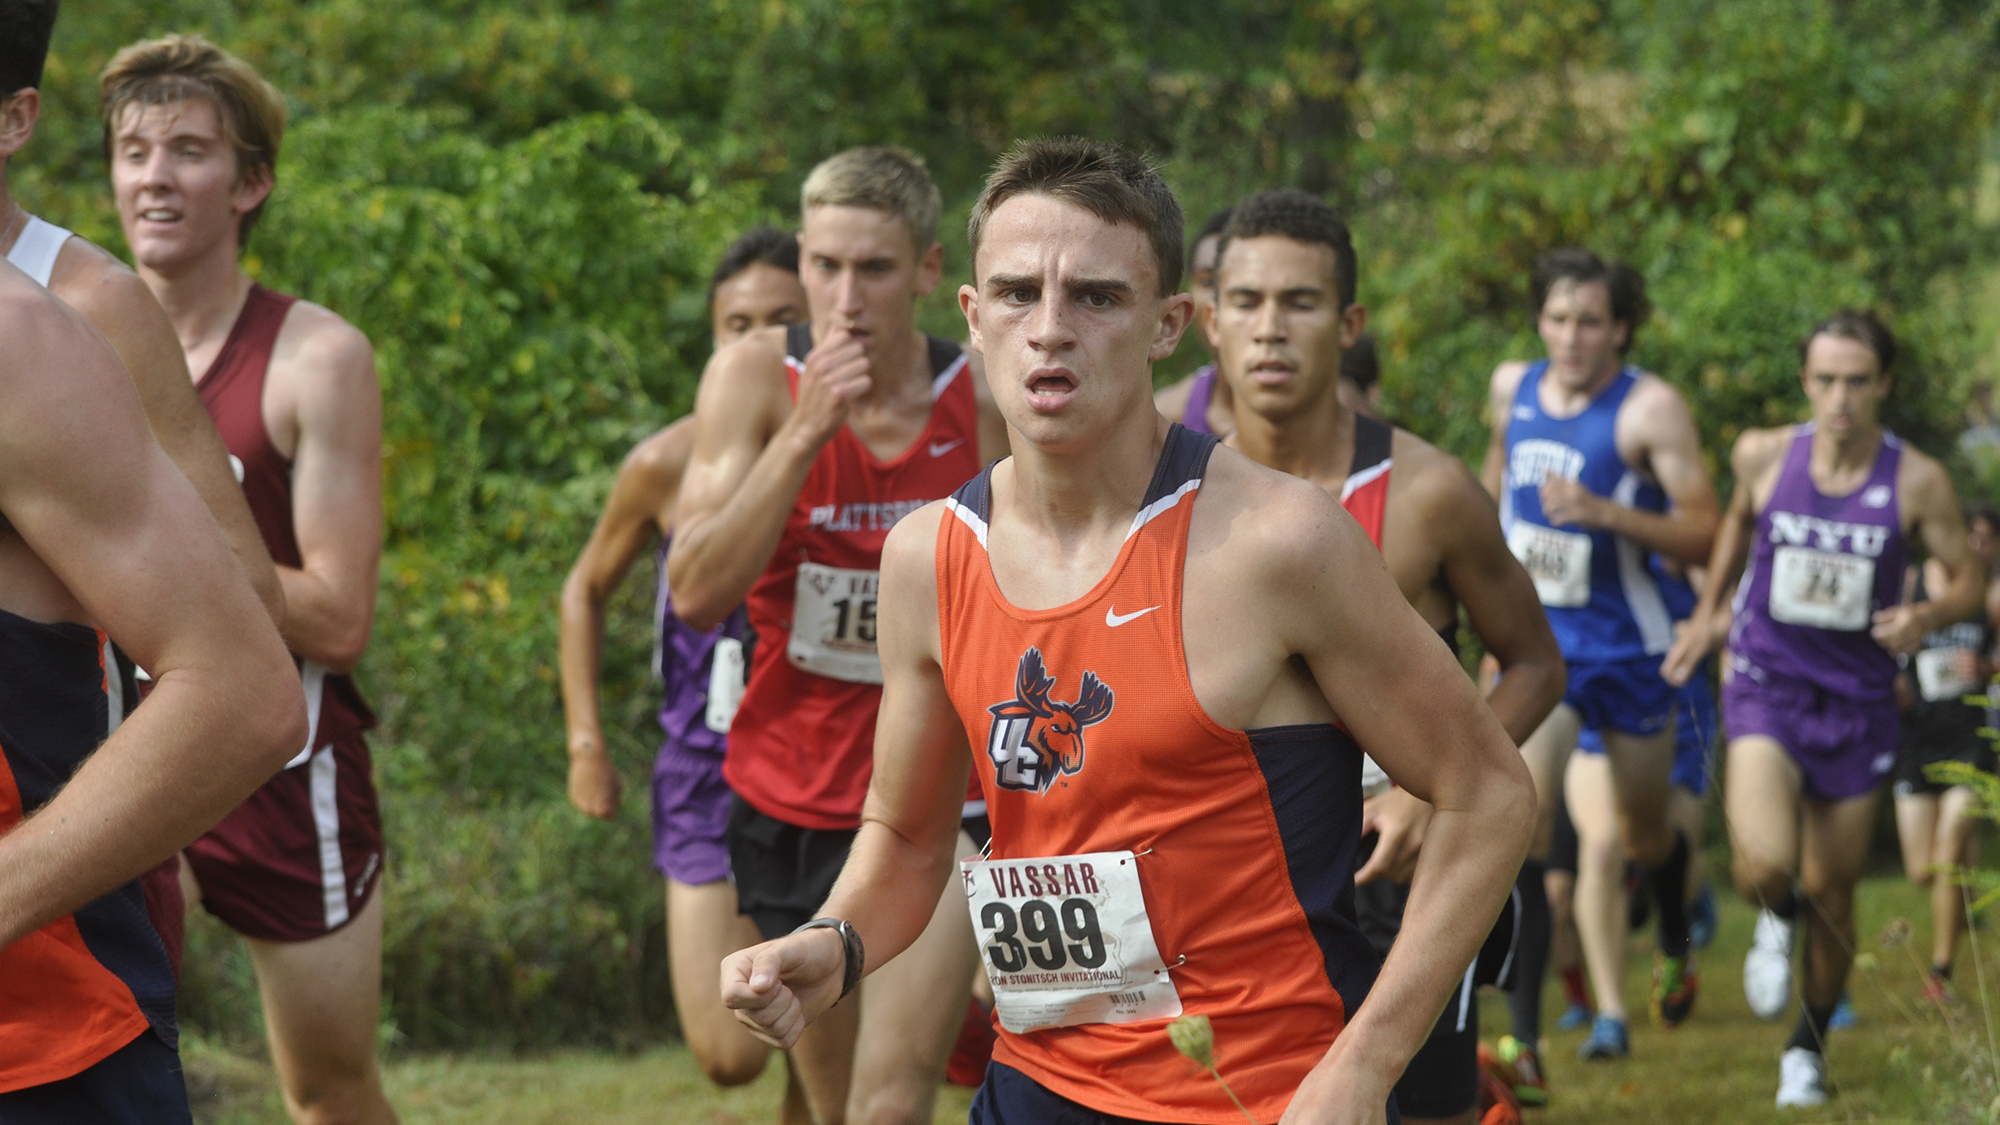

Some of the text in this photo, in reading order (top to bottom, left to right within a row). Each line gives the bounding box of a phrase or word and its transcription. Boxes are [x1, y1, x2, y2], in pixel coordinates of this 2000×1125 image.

[1769, 511, 1889, 556] NYU
[989, 863, 1099, 898] VASSAR
[980, 898, 1107, 972] 399
[1009, 972, 1058, 986] STONITSCH
[1061, 970, 1122, 982] INVITATIONAL
